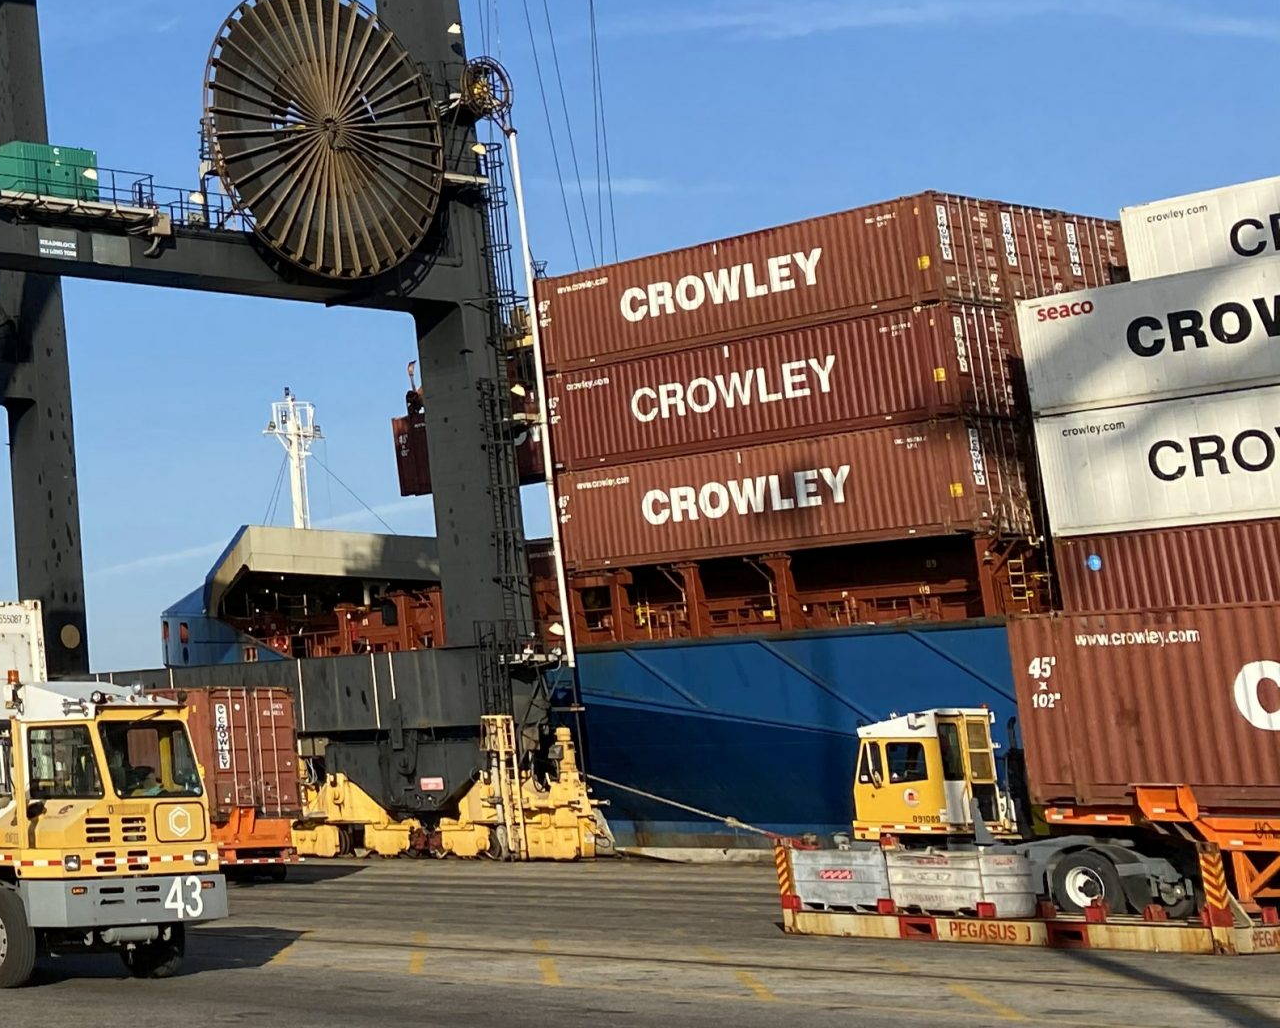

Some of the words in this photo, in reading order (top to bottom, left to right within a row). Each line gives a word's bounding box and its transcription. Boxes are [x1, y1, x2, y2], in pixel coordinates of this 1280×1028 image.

[1147, 204, 1208, 223] crowley.com
[1229, 213, 1280, 257] C
[620, 248, 822, 322] CROWLEY
[1037, 300, 1094, 322] seaco
[631, 355, 836, 422] CROWLEY
[1062, 420, 1125, 438] crowley.com
[1148, 426, 1280, 482] CRO
[641, 465, 850, 525] CROWLEY
[0, 614, 22, 623] 555087
[25, 614, 31, 624] 5
[1075, 628, 1201, 647] www.crowley.com
[1028, 657, 1056, 679] 45'
[1032, 693, 1061, 708] 102"
[164, 876, 204, 919] 43
[949, 921, 1017, 942] PEGASUS
[1025, 925, 1032, 942] J
[1252, 930, 1280, 948] PEGA
